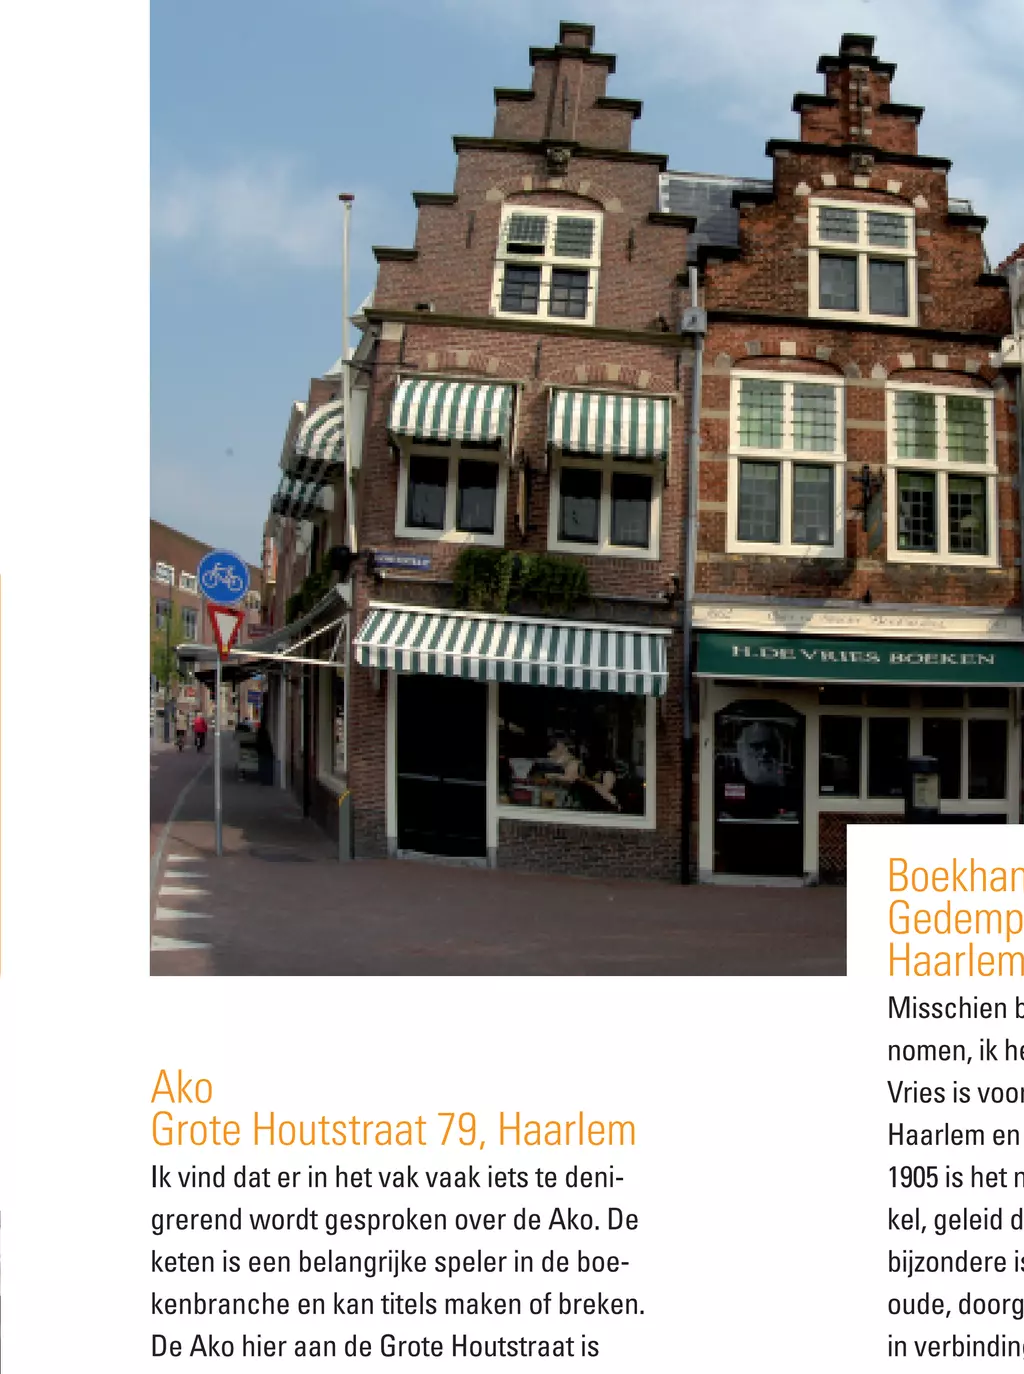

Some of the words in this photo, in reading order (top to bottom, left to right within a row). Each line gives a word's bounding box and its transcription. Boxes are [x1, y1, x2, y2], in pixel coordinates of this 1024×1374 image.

[800, 648, 881, 663] VRIES
[889, 652, 995, 665] BOEKEN
[889, 942, 1024, 977] Haarlem
[150, 1068, 213, 1104] Ako
[152, 1110, 241, 1147] Grote
[253, 1111, 427, 1147] Houtstraat
[437, 1111, 486, 1151] 79,
[499, 1110, 636, 1147] Haarlem
[888, 1122, 985, 1146] Haarlem
[992, 1128, 1020, 1146] en
[151, 1291, 290, 1315] kenbranche
[297, 1297, 325, 1315] en
[333, 1291, 374, 1315] kan
[380, 1291, 437, 1315] titels
[445, 1291, 521, 1315] maken
[529, 1291, 552, 1315] of
[559, 1291, 645, 1315] breken.
[888, 1291, 952, 1319] oude,
